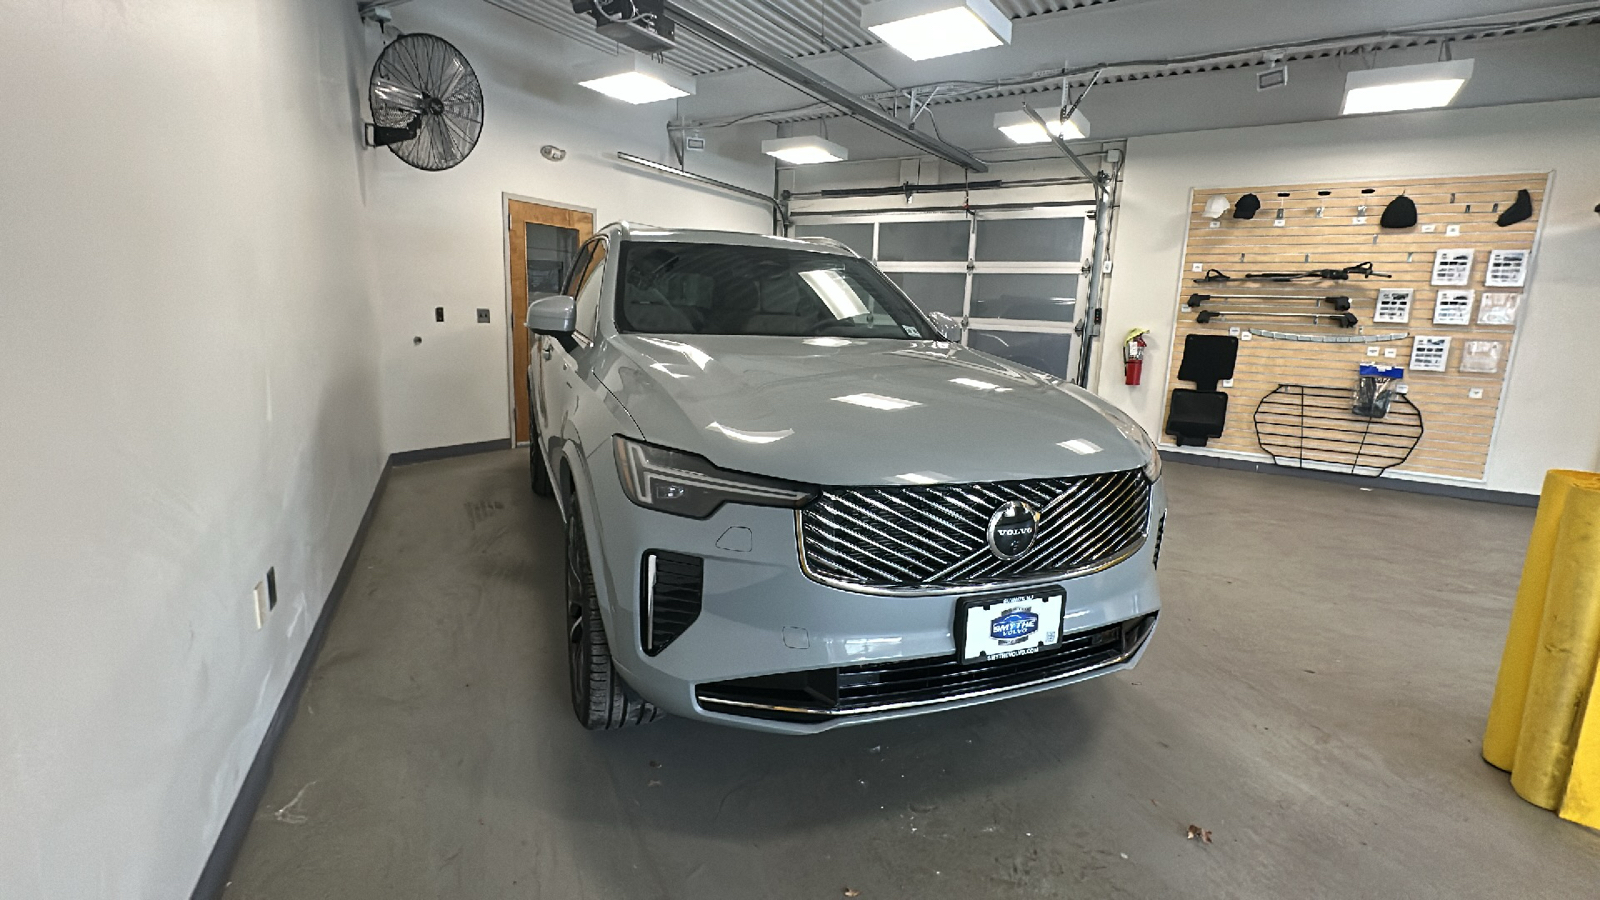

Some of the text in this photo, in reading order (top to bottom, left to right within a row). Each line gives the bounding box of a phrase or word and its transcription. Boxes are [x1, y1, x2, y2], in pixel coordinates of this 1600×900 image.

[997, 527, 1033, 535] VOLVO
[993, 619, 1035, 633] SMYTHE
[1002, 628, 1028, 636] VOLVO
